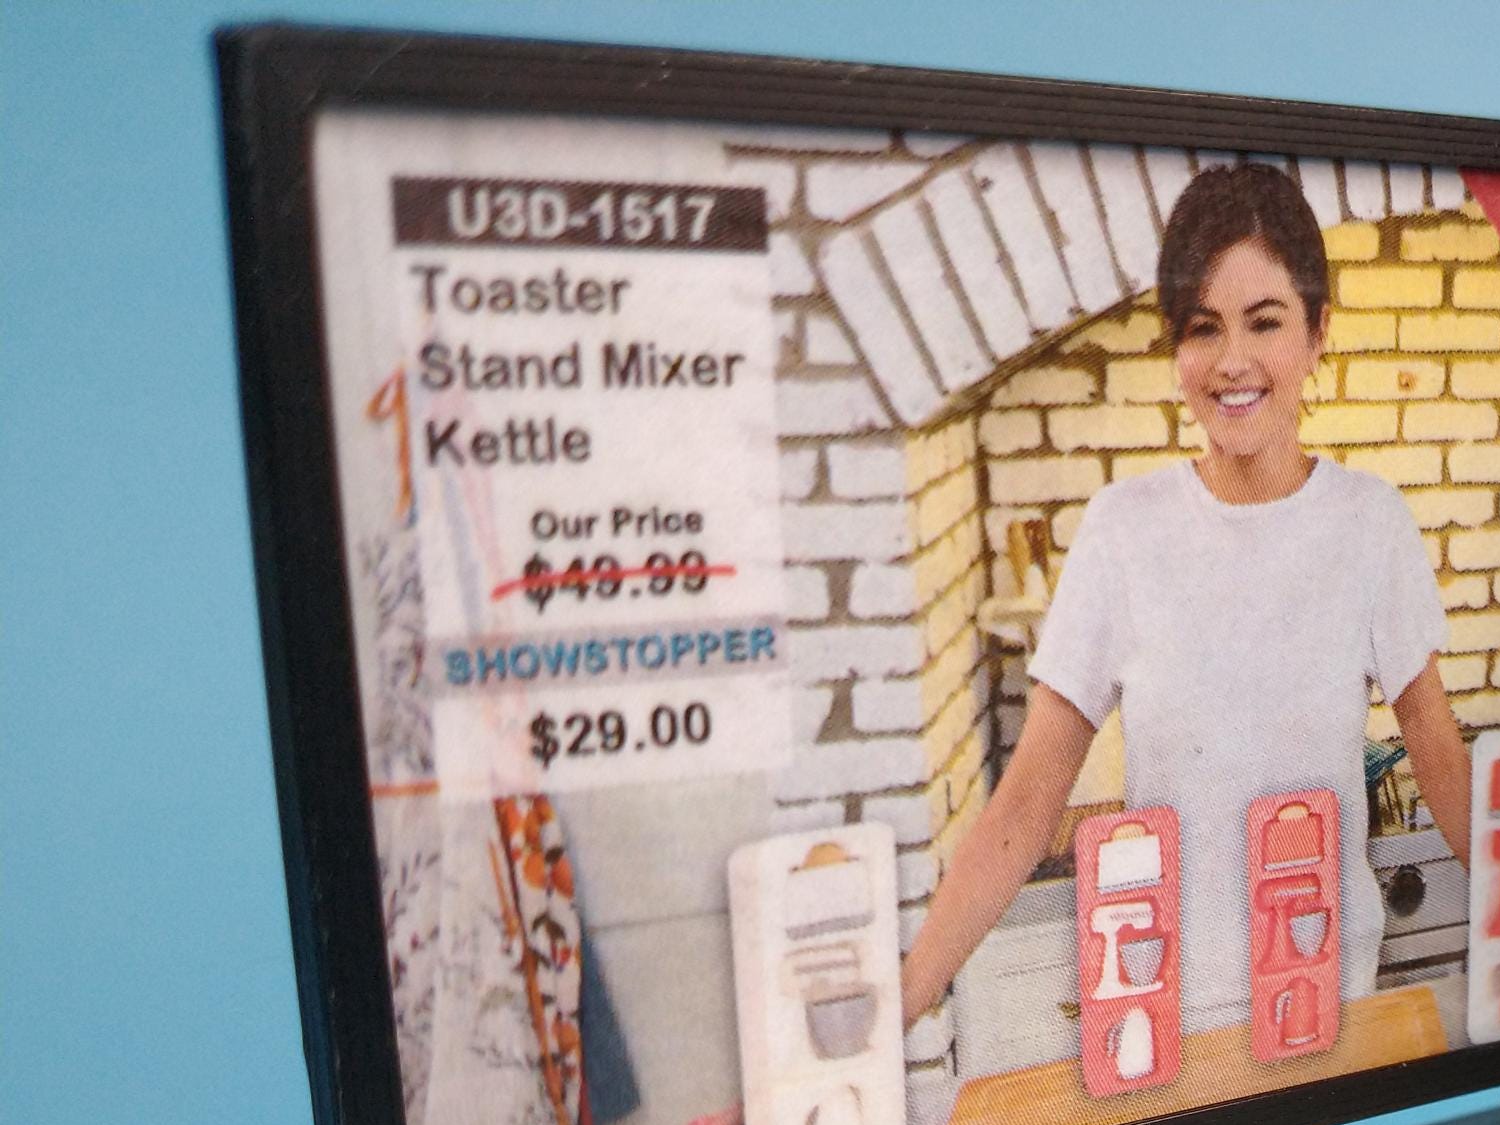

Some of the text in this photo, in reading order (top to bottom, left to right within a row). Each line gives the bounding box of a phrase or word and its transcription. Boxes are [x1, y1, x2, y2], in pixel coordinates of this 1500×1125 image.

[446, 186, 717, 243] U3D-1517
[410, 263, 631, 315] Toaster
[419, 340, 745, 391] Stand Mixer
[424, 416, 591, 466] Kettle
[530, 506, 706, 541] Our Price
[444, 625, 777, 686] SHOWSTOPPER
[529, 702, 712, 770] $29.00
